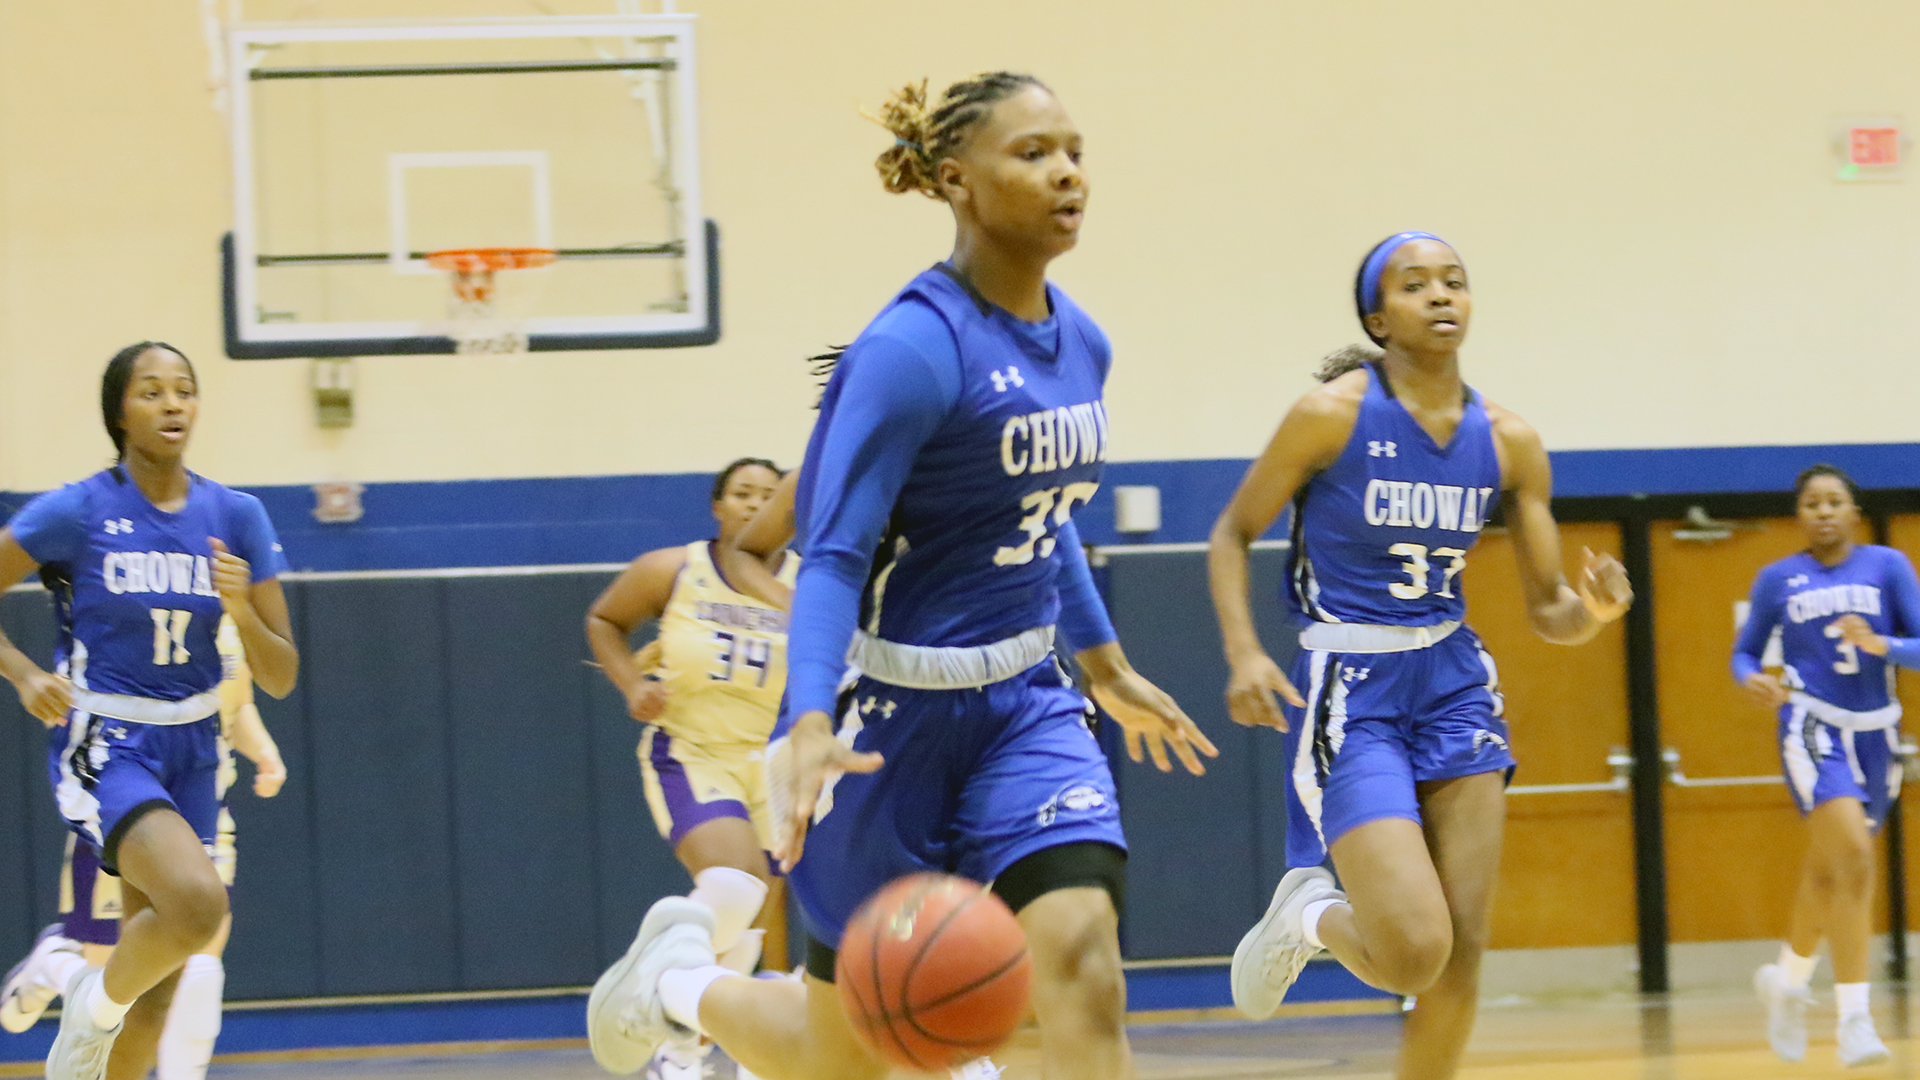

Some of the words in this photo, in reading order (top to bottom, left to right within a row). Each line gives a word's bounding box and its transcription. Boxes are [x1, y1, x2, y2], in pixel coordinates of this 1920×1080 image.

[1001, 400, 1108, 476] CHOW
[103, 551, 221, 598] CHOWA
[1388, 542, 1467, 600] 37
[149, 607, 193, 665] 11
[708, 630, 771, 688] 34
